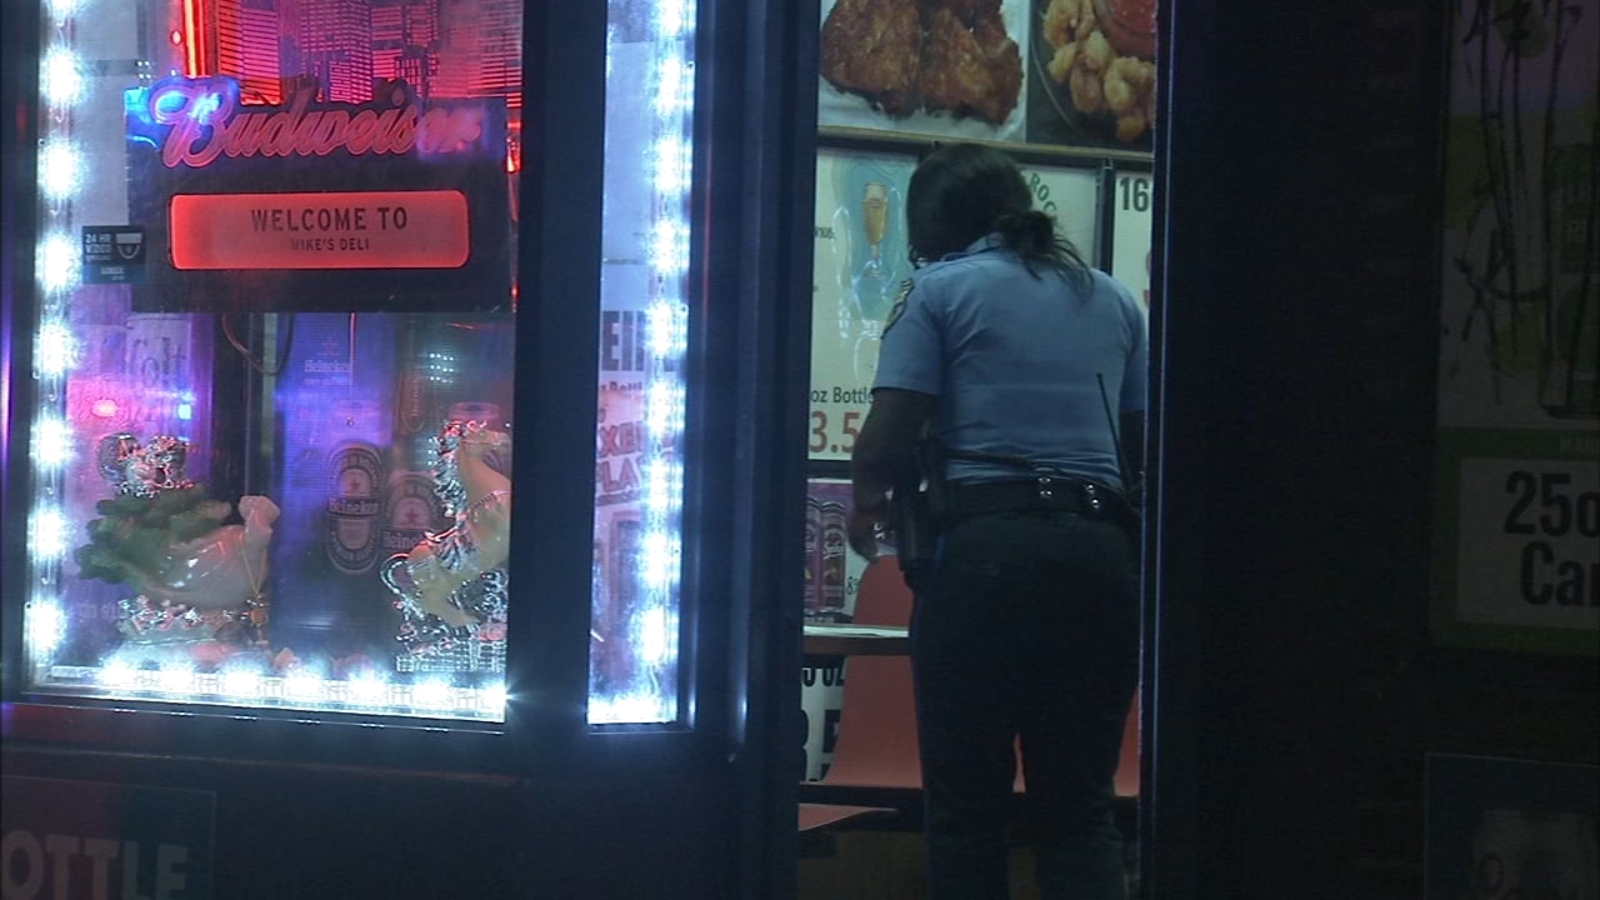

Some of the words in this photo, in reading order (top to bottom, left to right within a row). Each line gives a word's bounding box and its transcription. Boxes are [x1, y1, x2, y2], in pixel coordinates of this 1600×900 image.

[150, 83, 481, 168] Budweiser
[1120, 177, 1149, 212] 16
[251, 207, 367, 232] WELCOME
[378, 206, 408, 230] TO
[291, 238, 335, 251] MIKE'S
[339, 237, 370, 251] DELI
[811, 389, 828, 403] oz
